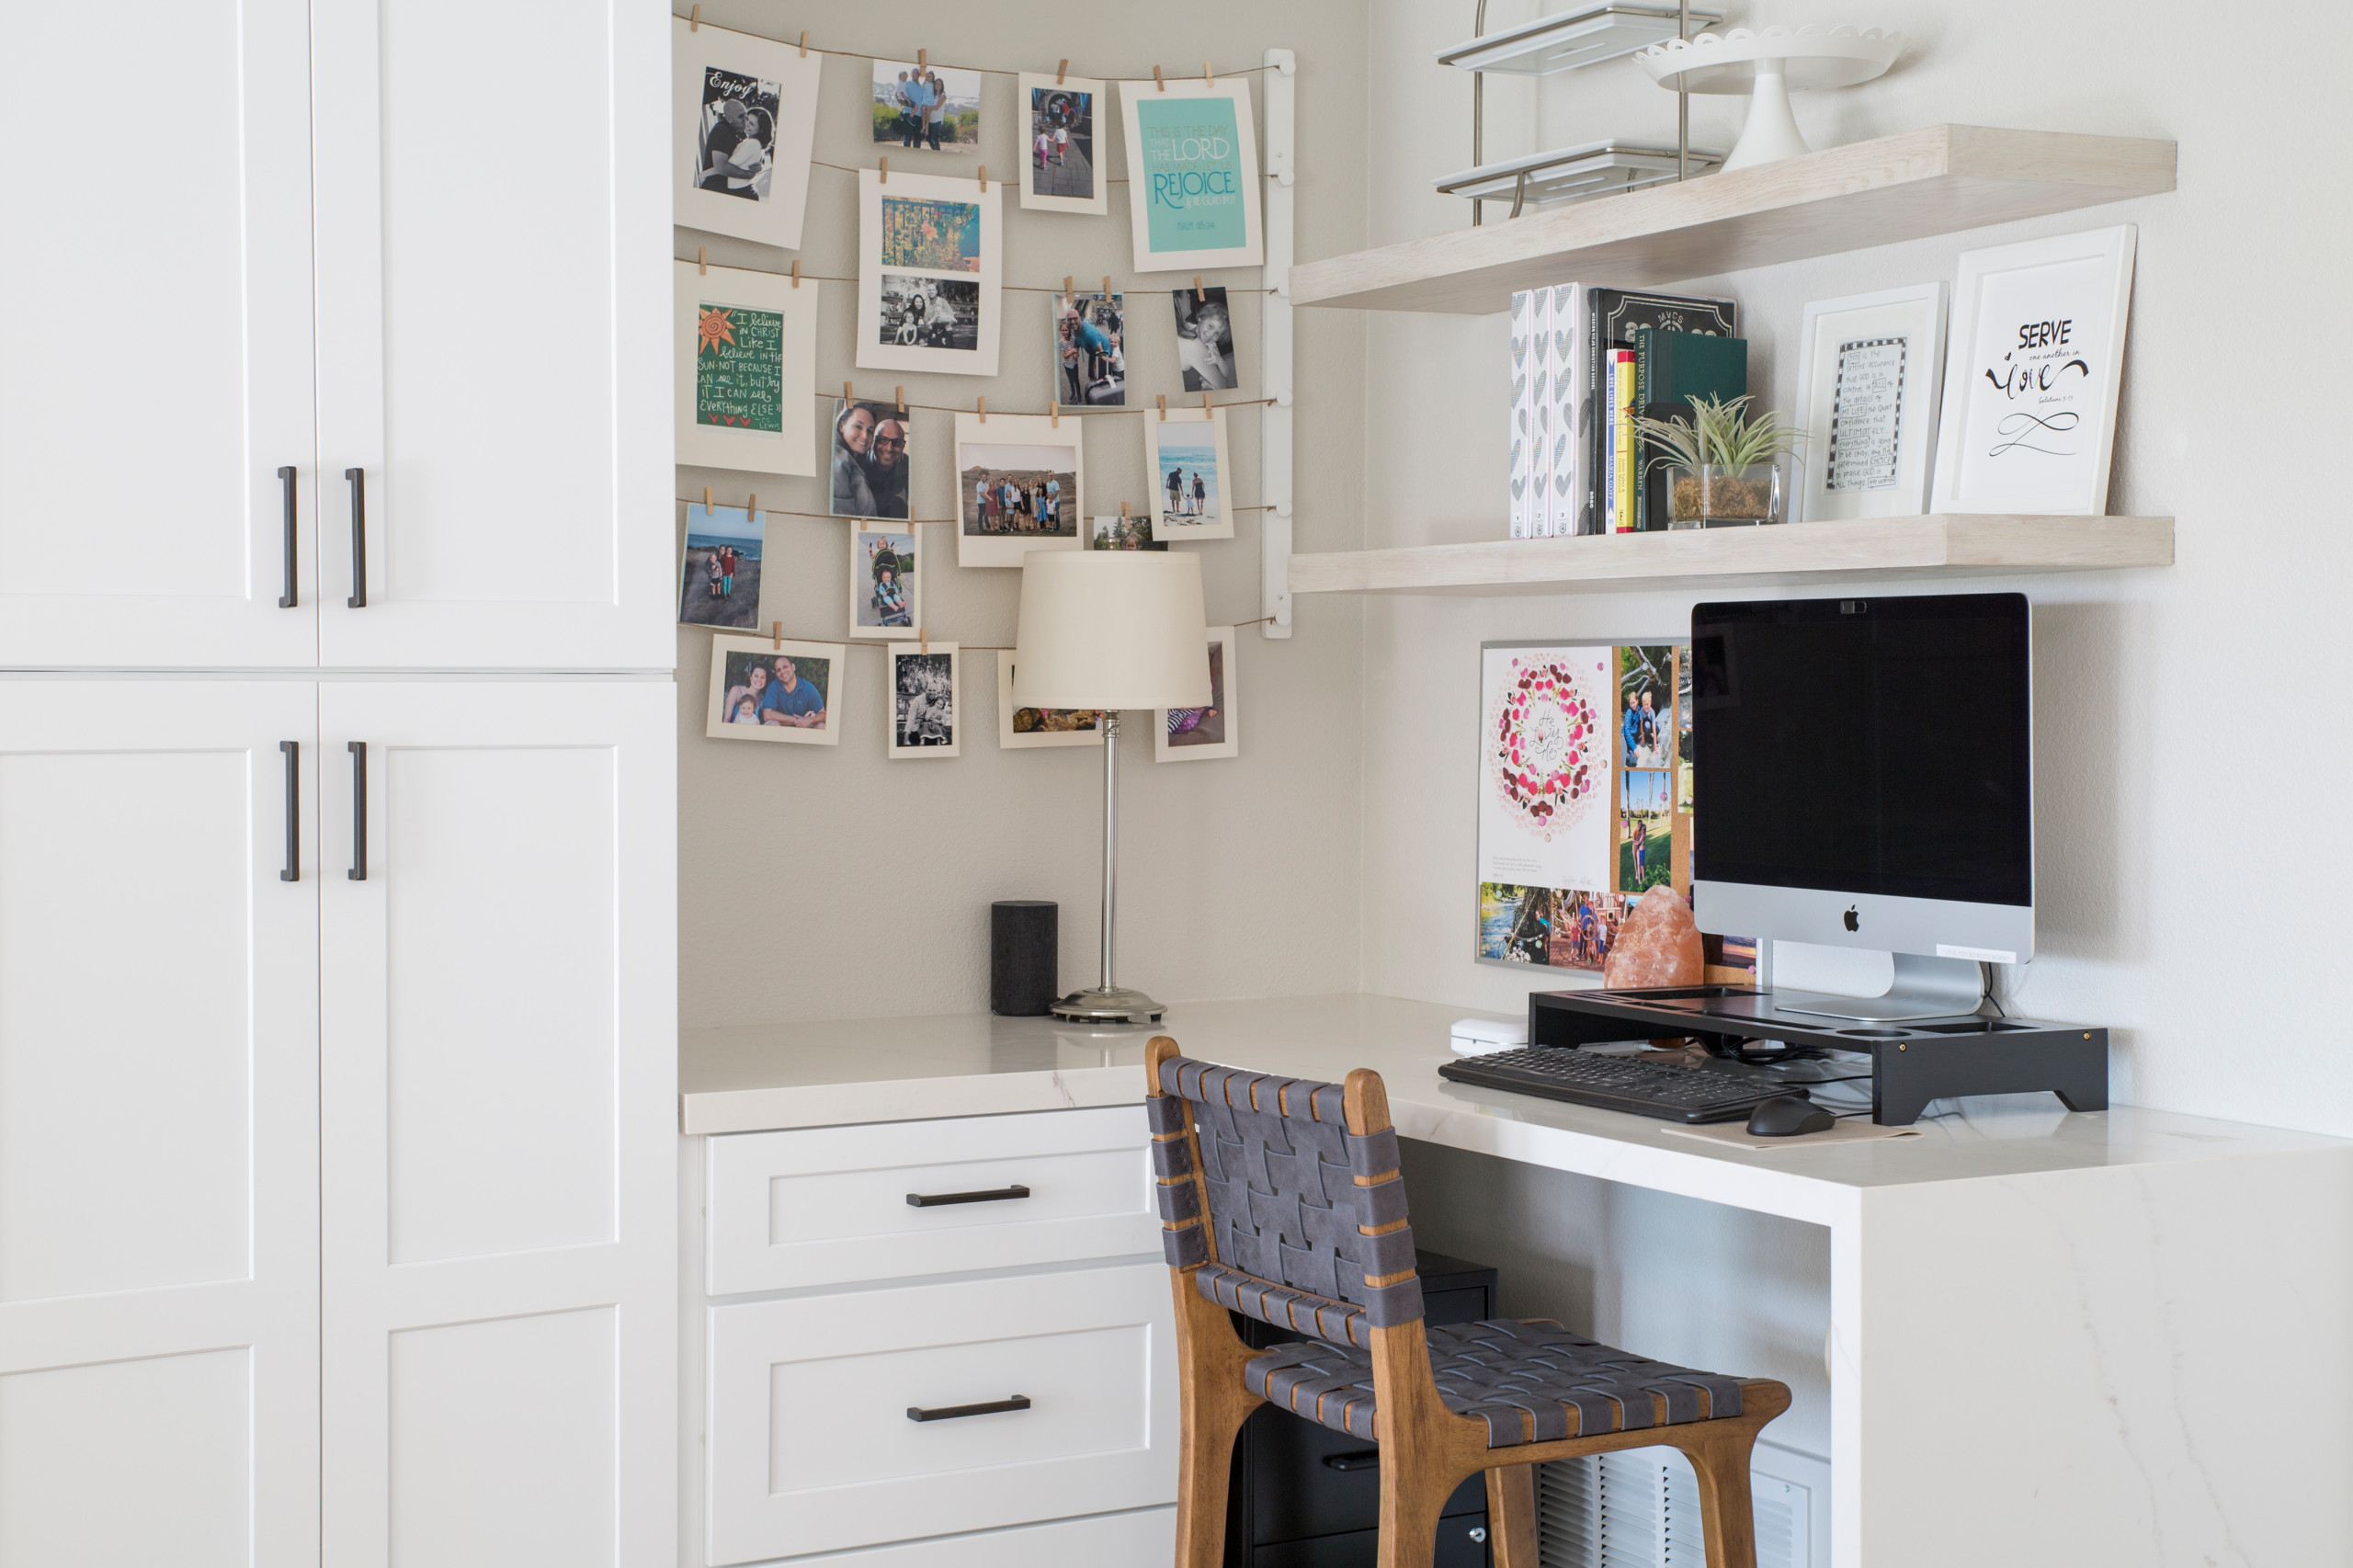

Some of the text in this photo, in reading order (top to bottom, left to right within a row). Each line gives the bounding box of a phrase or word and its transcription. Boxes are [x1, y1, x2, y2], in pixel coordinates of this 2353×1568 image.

[707, 72, 753, 99] Enjoy
[1184, 125, 1205, 137] THE
[1209, 125, 1229, 136] DAY
[1172, 137, 1230, 161] LORD
[1153, 171, 1235, 209] REJOICE
[749, 312, 782, 328] believe
[1658, 311, 1683, 324] MVCS
[2018, 319, 2072, 349] SERVE
[740, 336, 778, 351] Like I
[719, 346, 755, 359] believe
[2043, 348, 2070, 359] another
[739, 362, 773, 375] BECAUSE
[773, 366, 782, 376] I
[716, 375, 734, 385] see
[767, 375, 780, 393] by
[1875, 380, 1886, 389] ALL
[713, 386, 725, 398] I
[727, 388, 747, 399] CAN
[750, 390, 772, 403] see
[1852, 406, 1864, 415] LIFE
[1539, 708, 1555, 727] He
[1535, 740, 1557, 761] Me
